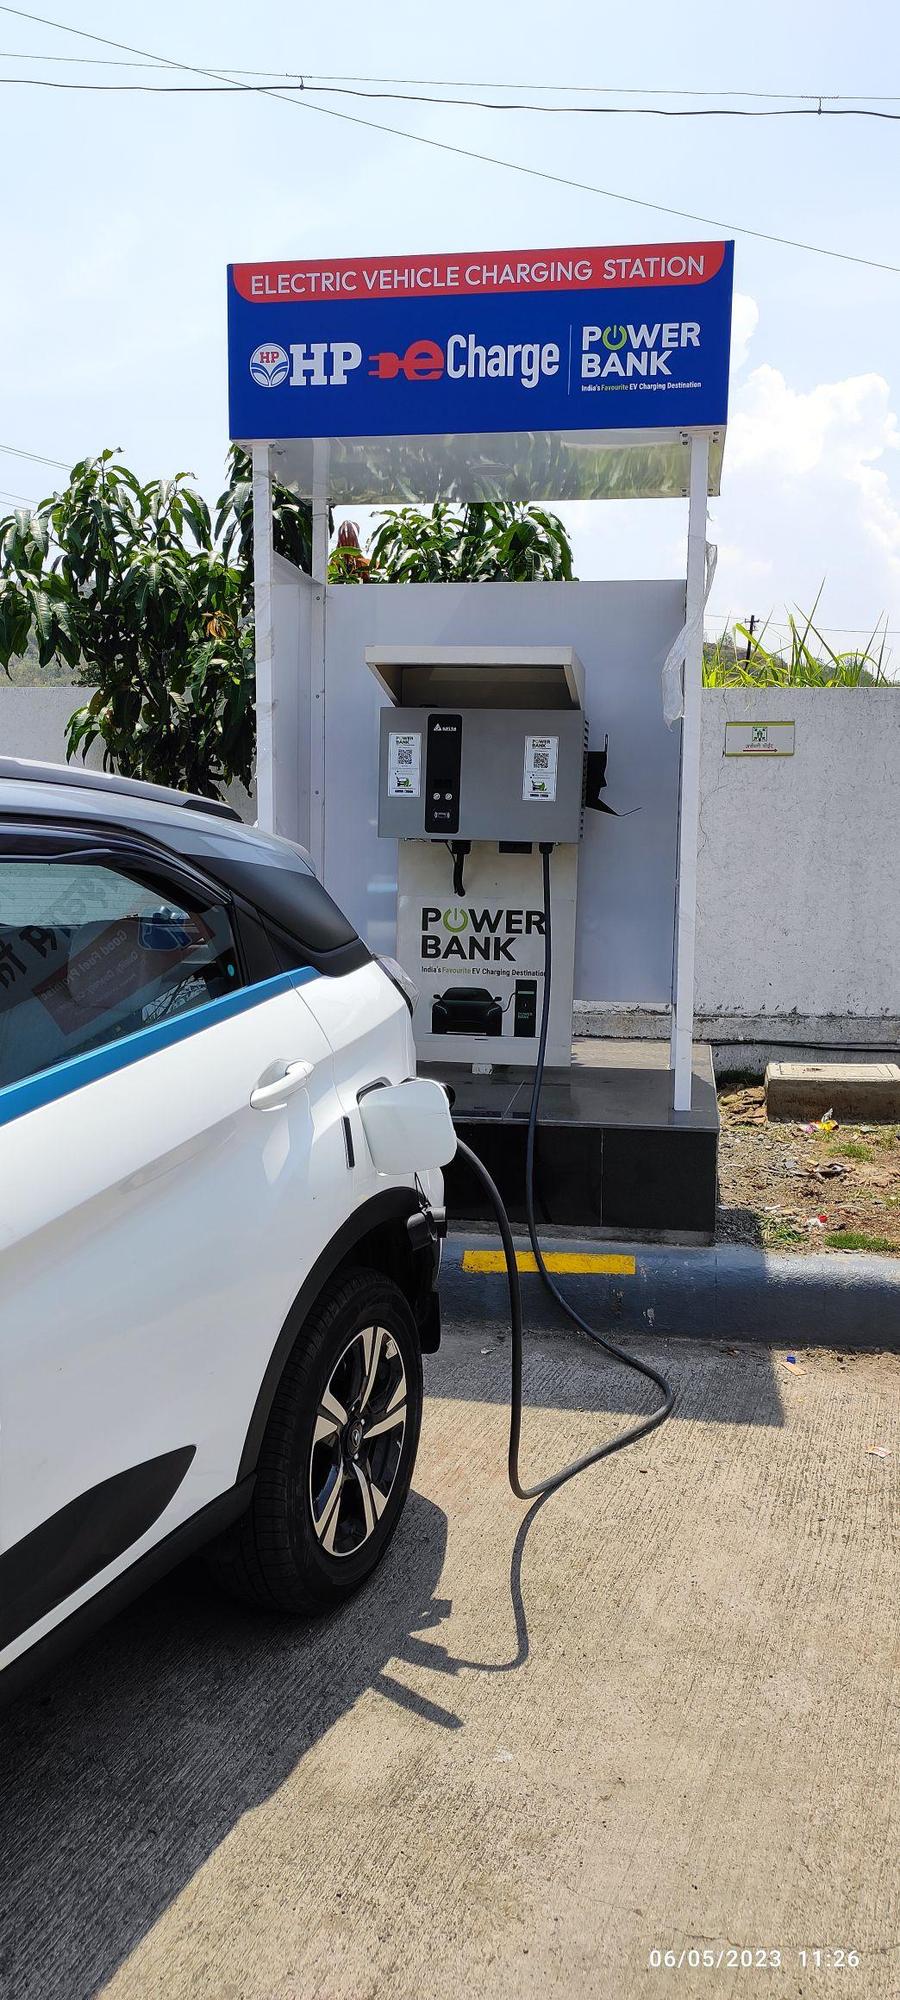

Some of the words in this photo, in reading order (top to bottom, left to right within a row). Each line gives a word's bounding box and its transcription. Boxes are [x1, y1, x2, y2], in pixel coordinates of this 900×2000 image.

[251, 271, 357, 295] ELECTRIC
[362, 266, 460, 290] VEHICLE
[464, 260, 593, 286] CHARGING
[603, 255, 705, 280] STATION
[581, 322, 701, 352] POWER
[259, 352, 280, 364] HP
[289, 342, 363, 387] HP
[580, 349, 672, 378] BANK
[581, 384, 601, 392] India's
[601, 383, 629, 391] Favourite
[629, 383, 638, 391] EV
[639, 381, 666, 391] Charging
[667, 380, 702, 390] Destination
[421, 907, 546, 935] POWER
[421, 935, 517, 962] BANK
[421, 965, 442, 974] India's
[442, 966, 471, 976] Favourite
[471, 967, 481, 975] EV
[481, 968, 511, 978] Charging
[511, 969, 546, 978] Destinatio
